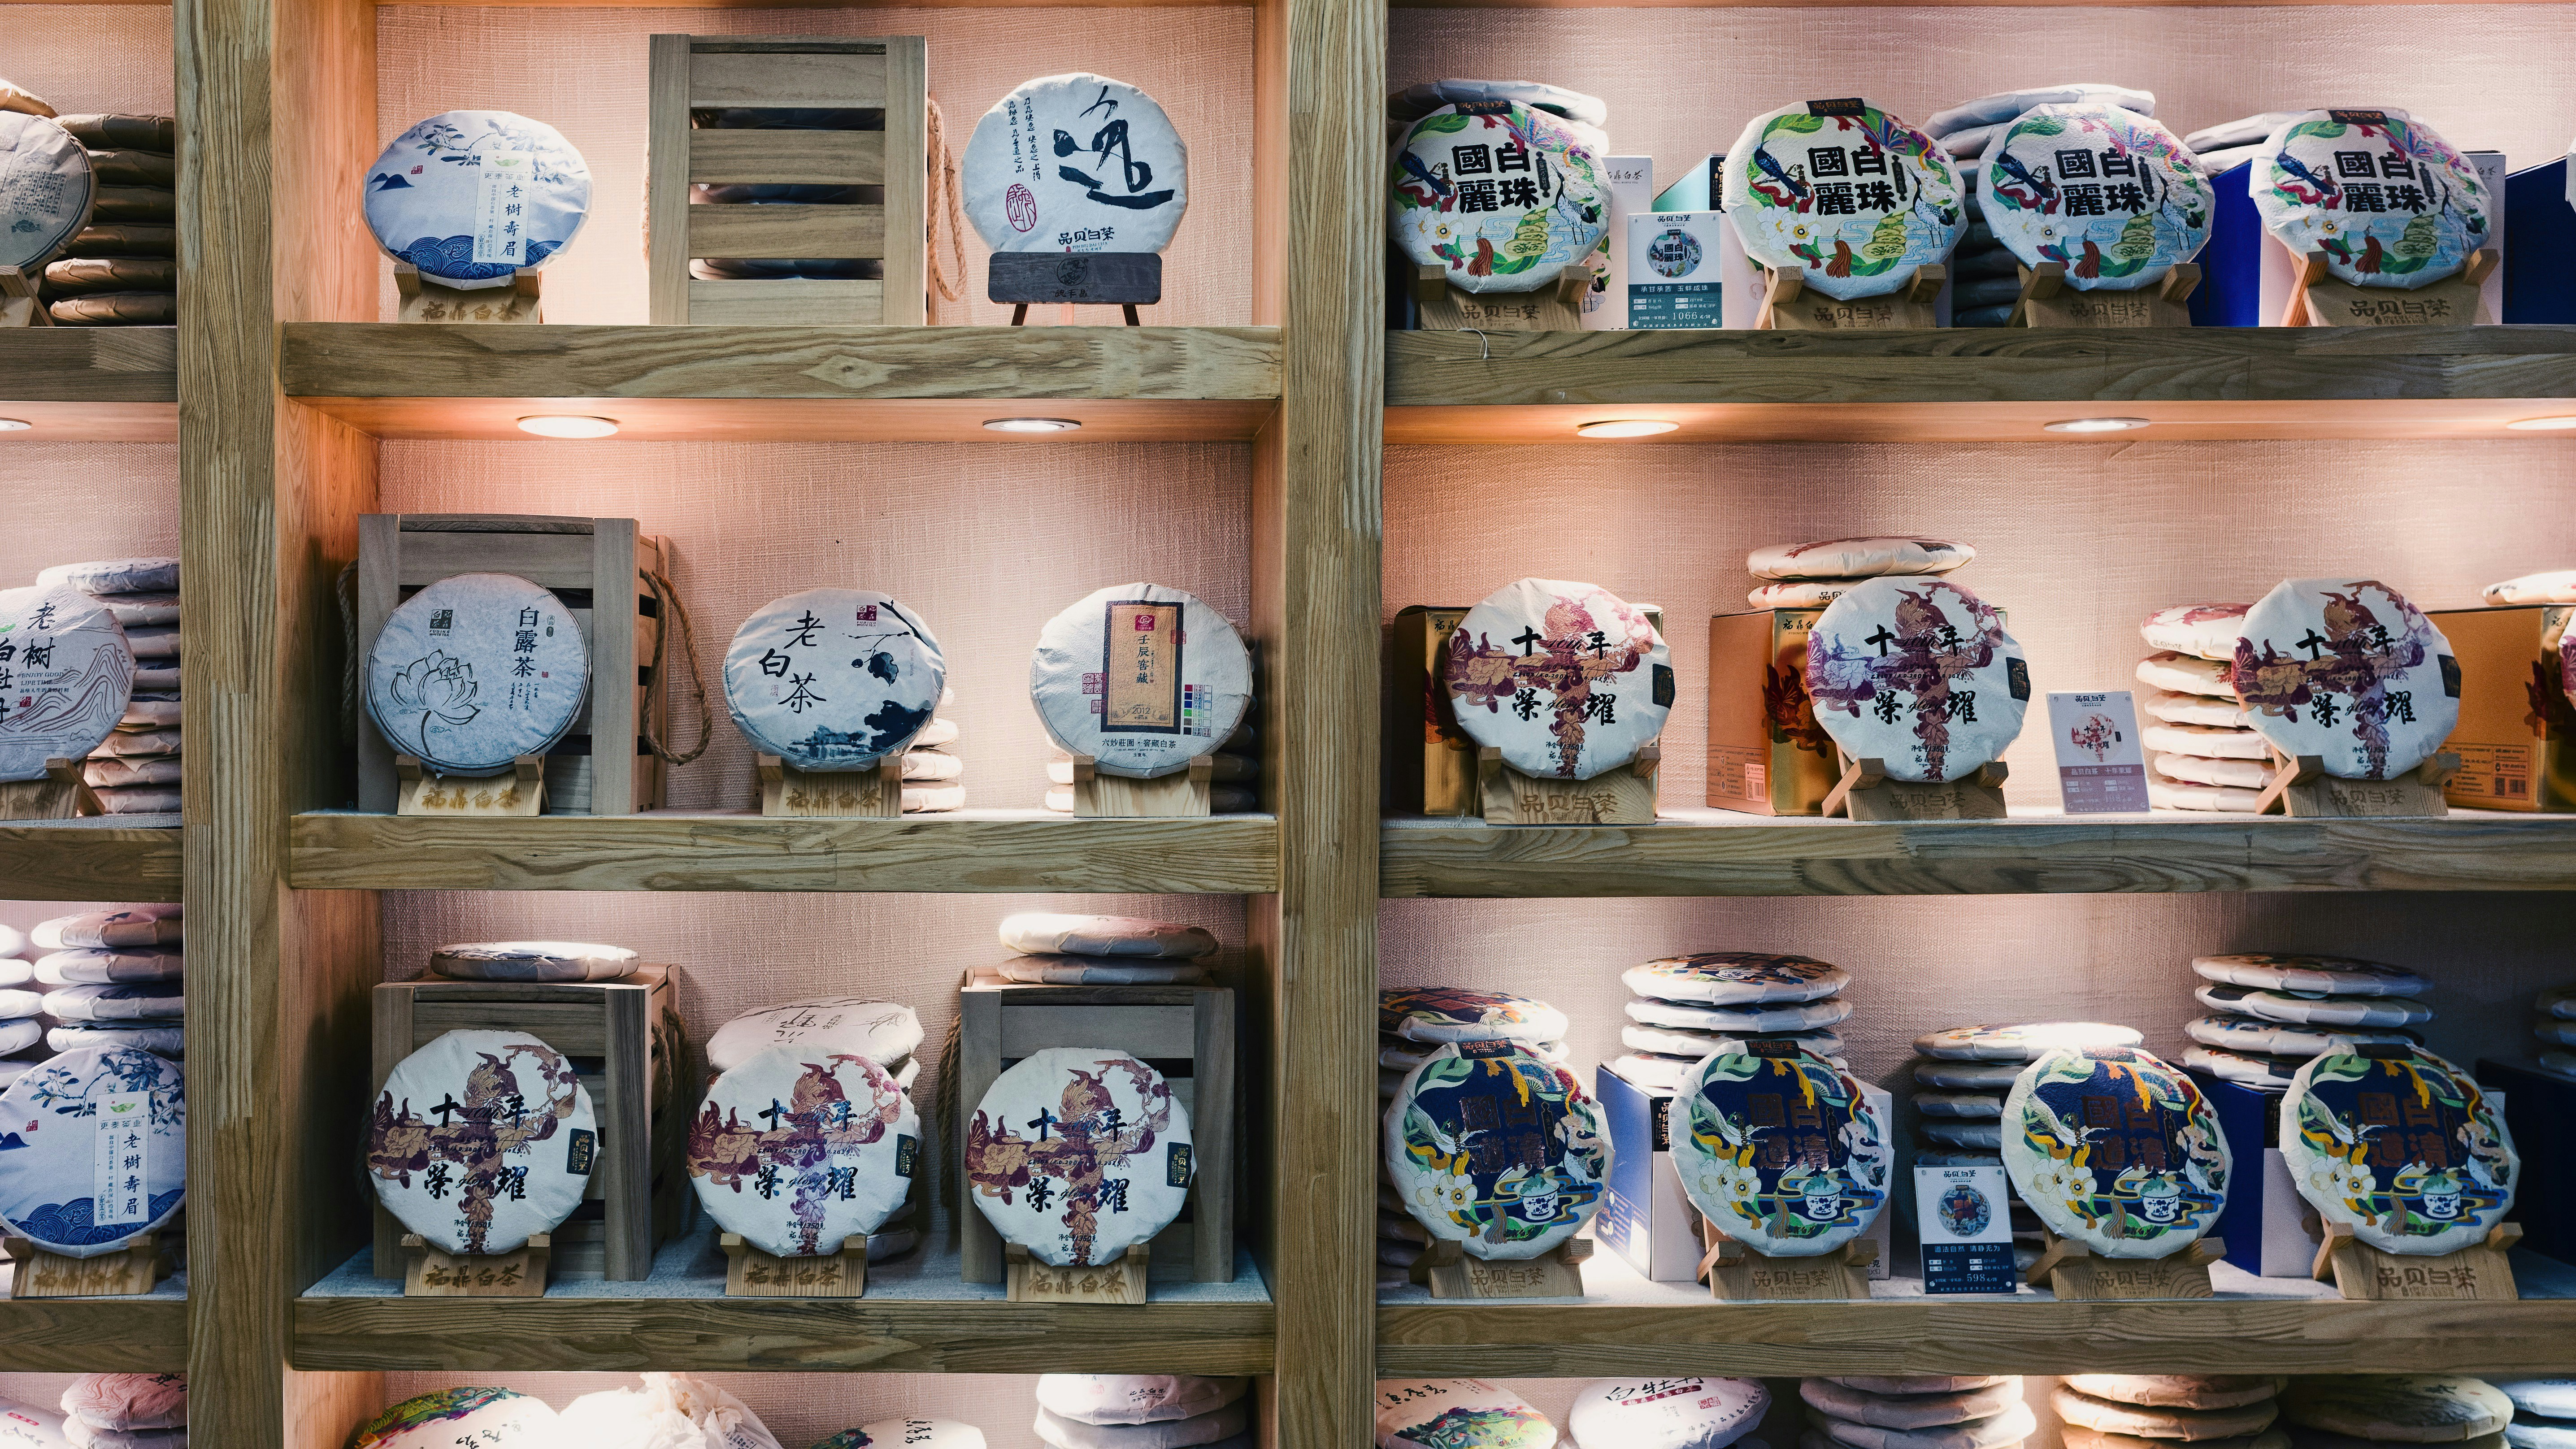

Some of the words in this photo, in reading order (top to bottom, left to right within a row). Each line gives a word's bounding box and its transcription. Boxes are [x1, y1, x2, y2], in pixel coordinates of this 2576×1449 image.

[500, 185, 523, 257] 老樹壽眉
[1058, 226, 1115, 245] 品贝白茶
[1462, 304, 1540, 320] 品贝白茶
[1672, 312, 1698, 321] 1066
[1814, 304, 1893, 322] 品贝白茶
[2349, 299, 2451, 317] 品贝白茶
[22, 602, 56, 669] 老树
[510, 606, 539, 677] 白露茶
[758, 610, 826, 714] 老白茶
[1520, 793, 1617, 815] 品贝白茶
[122, 1133, 141, 1216] 老樹壽眉
[426, 1264, 523, 1288] 福鼎白茶
[745, 1263, 842, 1287] 福鼎白茶
[1471, 1268, 1545, 1286] 品贝白茶
[1752, 1269, 1830, 1288] 品贝白茶
[1967, 1274, 1985, 1282] 598
[2379, 1266, 2476, 1289] 品贝白茶
